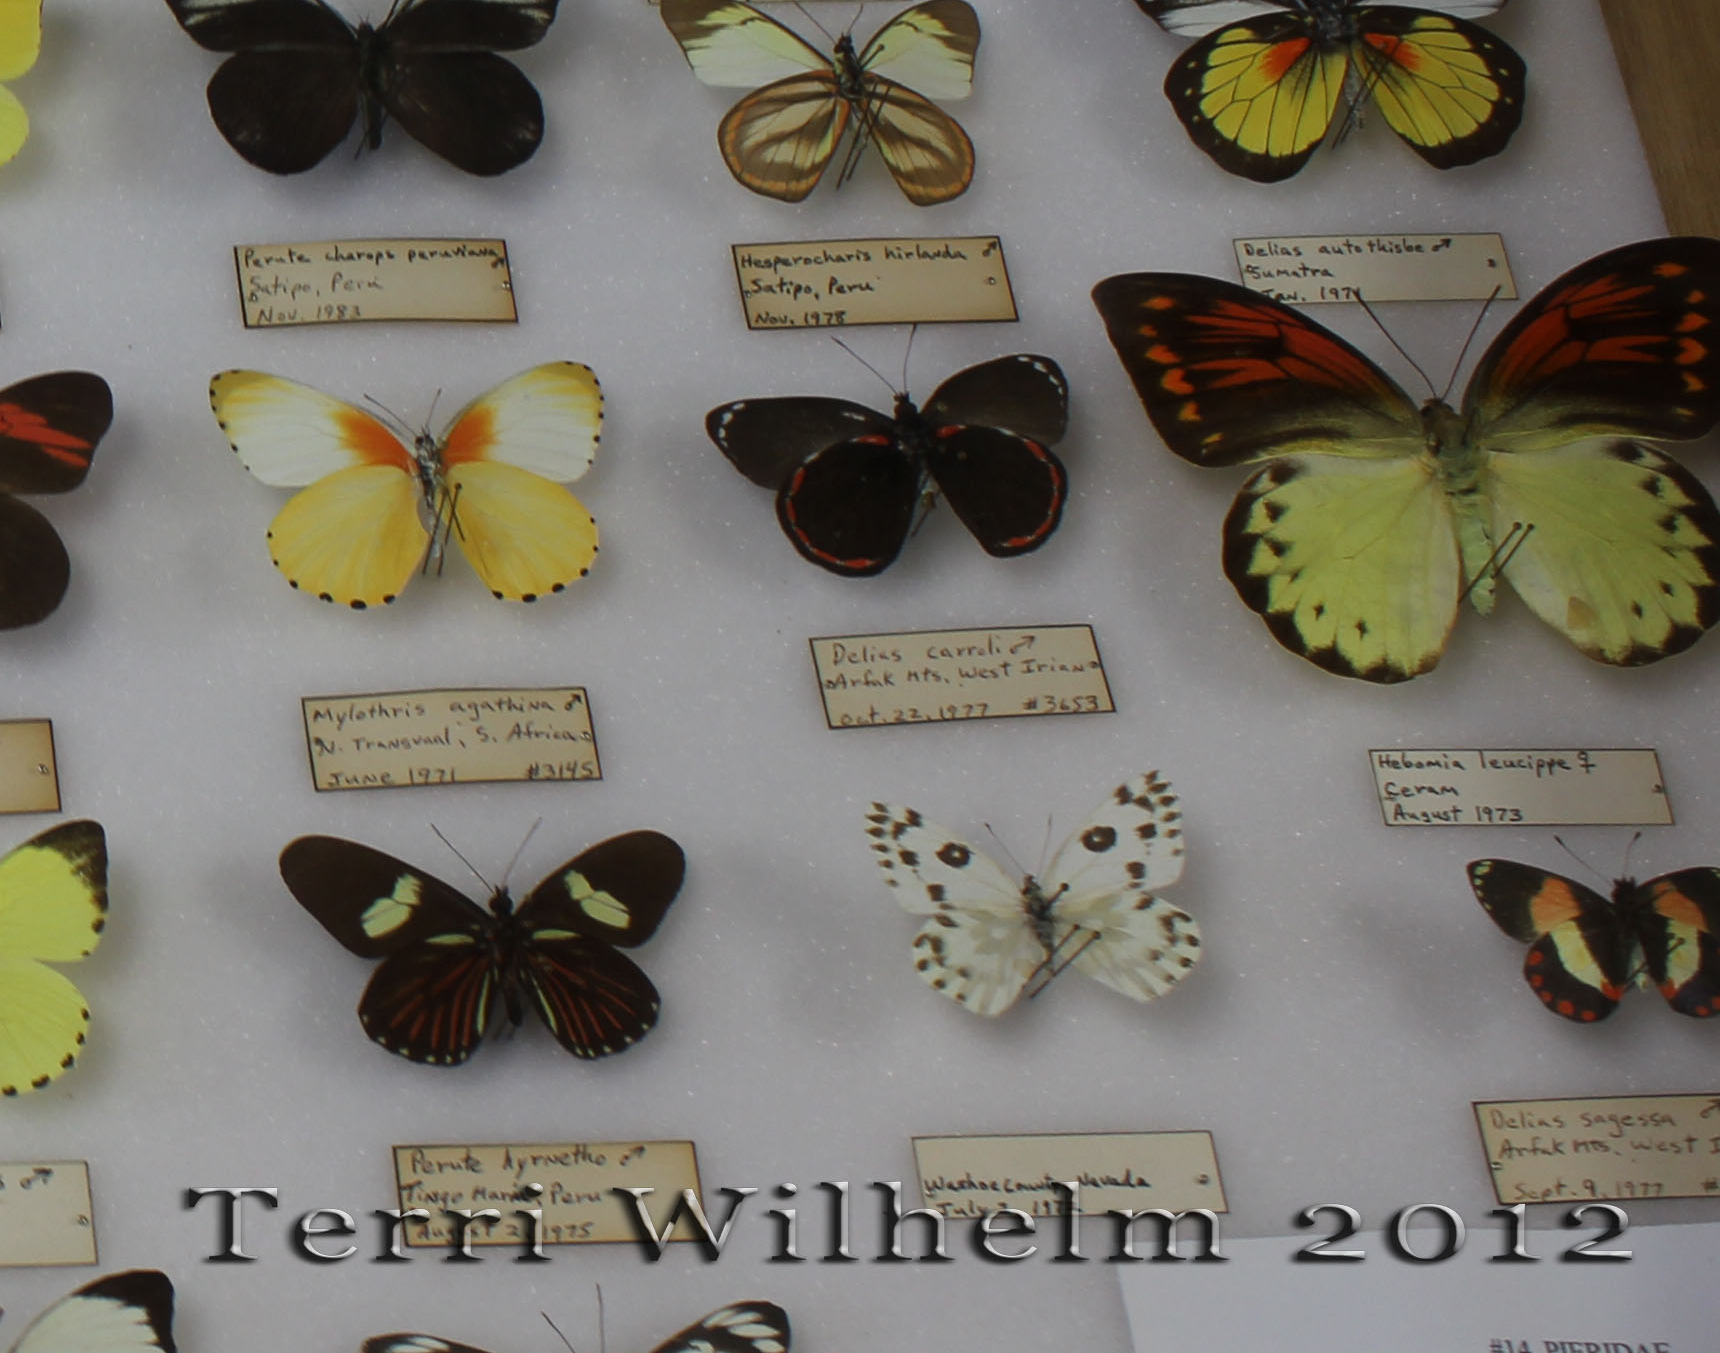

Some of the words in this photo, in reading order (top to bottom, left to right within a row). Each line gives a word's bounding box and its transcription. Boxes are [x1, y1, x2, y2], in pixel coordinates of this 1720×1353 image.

[1244, 240, 1303, 258] Delias
[1245, 261, 1335, 279] Sumatra
[828, 276, 875, 295] Peru
[832, 642, 903, 666] Delias
[1378, 753, 1467, 772] Hebomia
[1392, 804, 1463, 824] August
[1475, 805, 1524, 822] 1973
[1490, 1106, 1564, 1130] Delias
